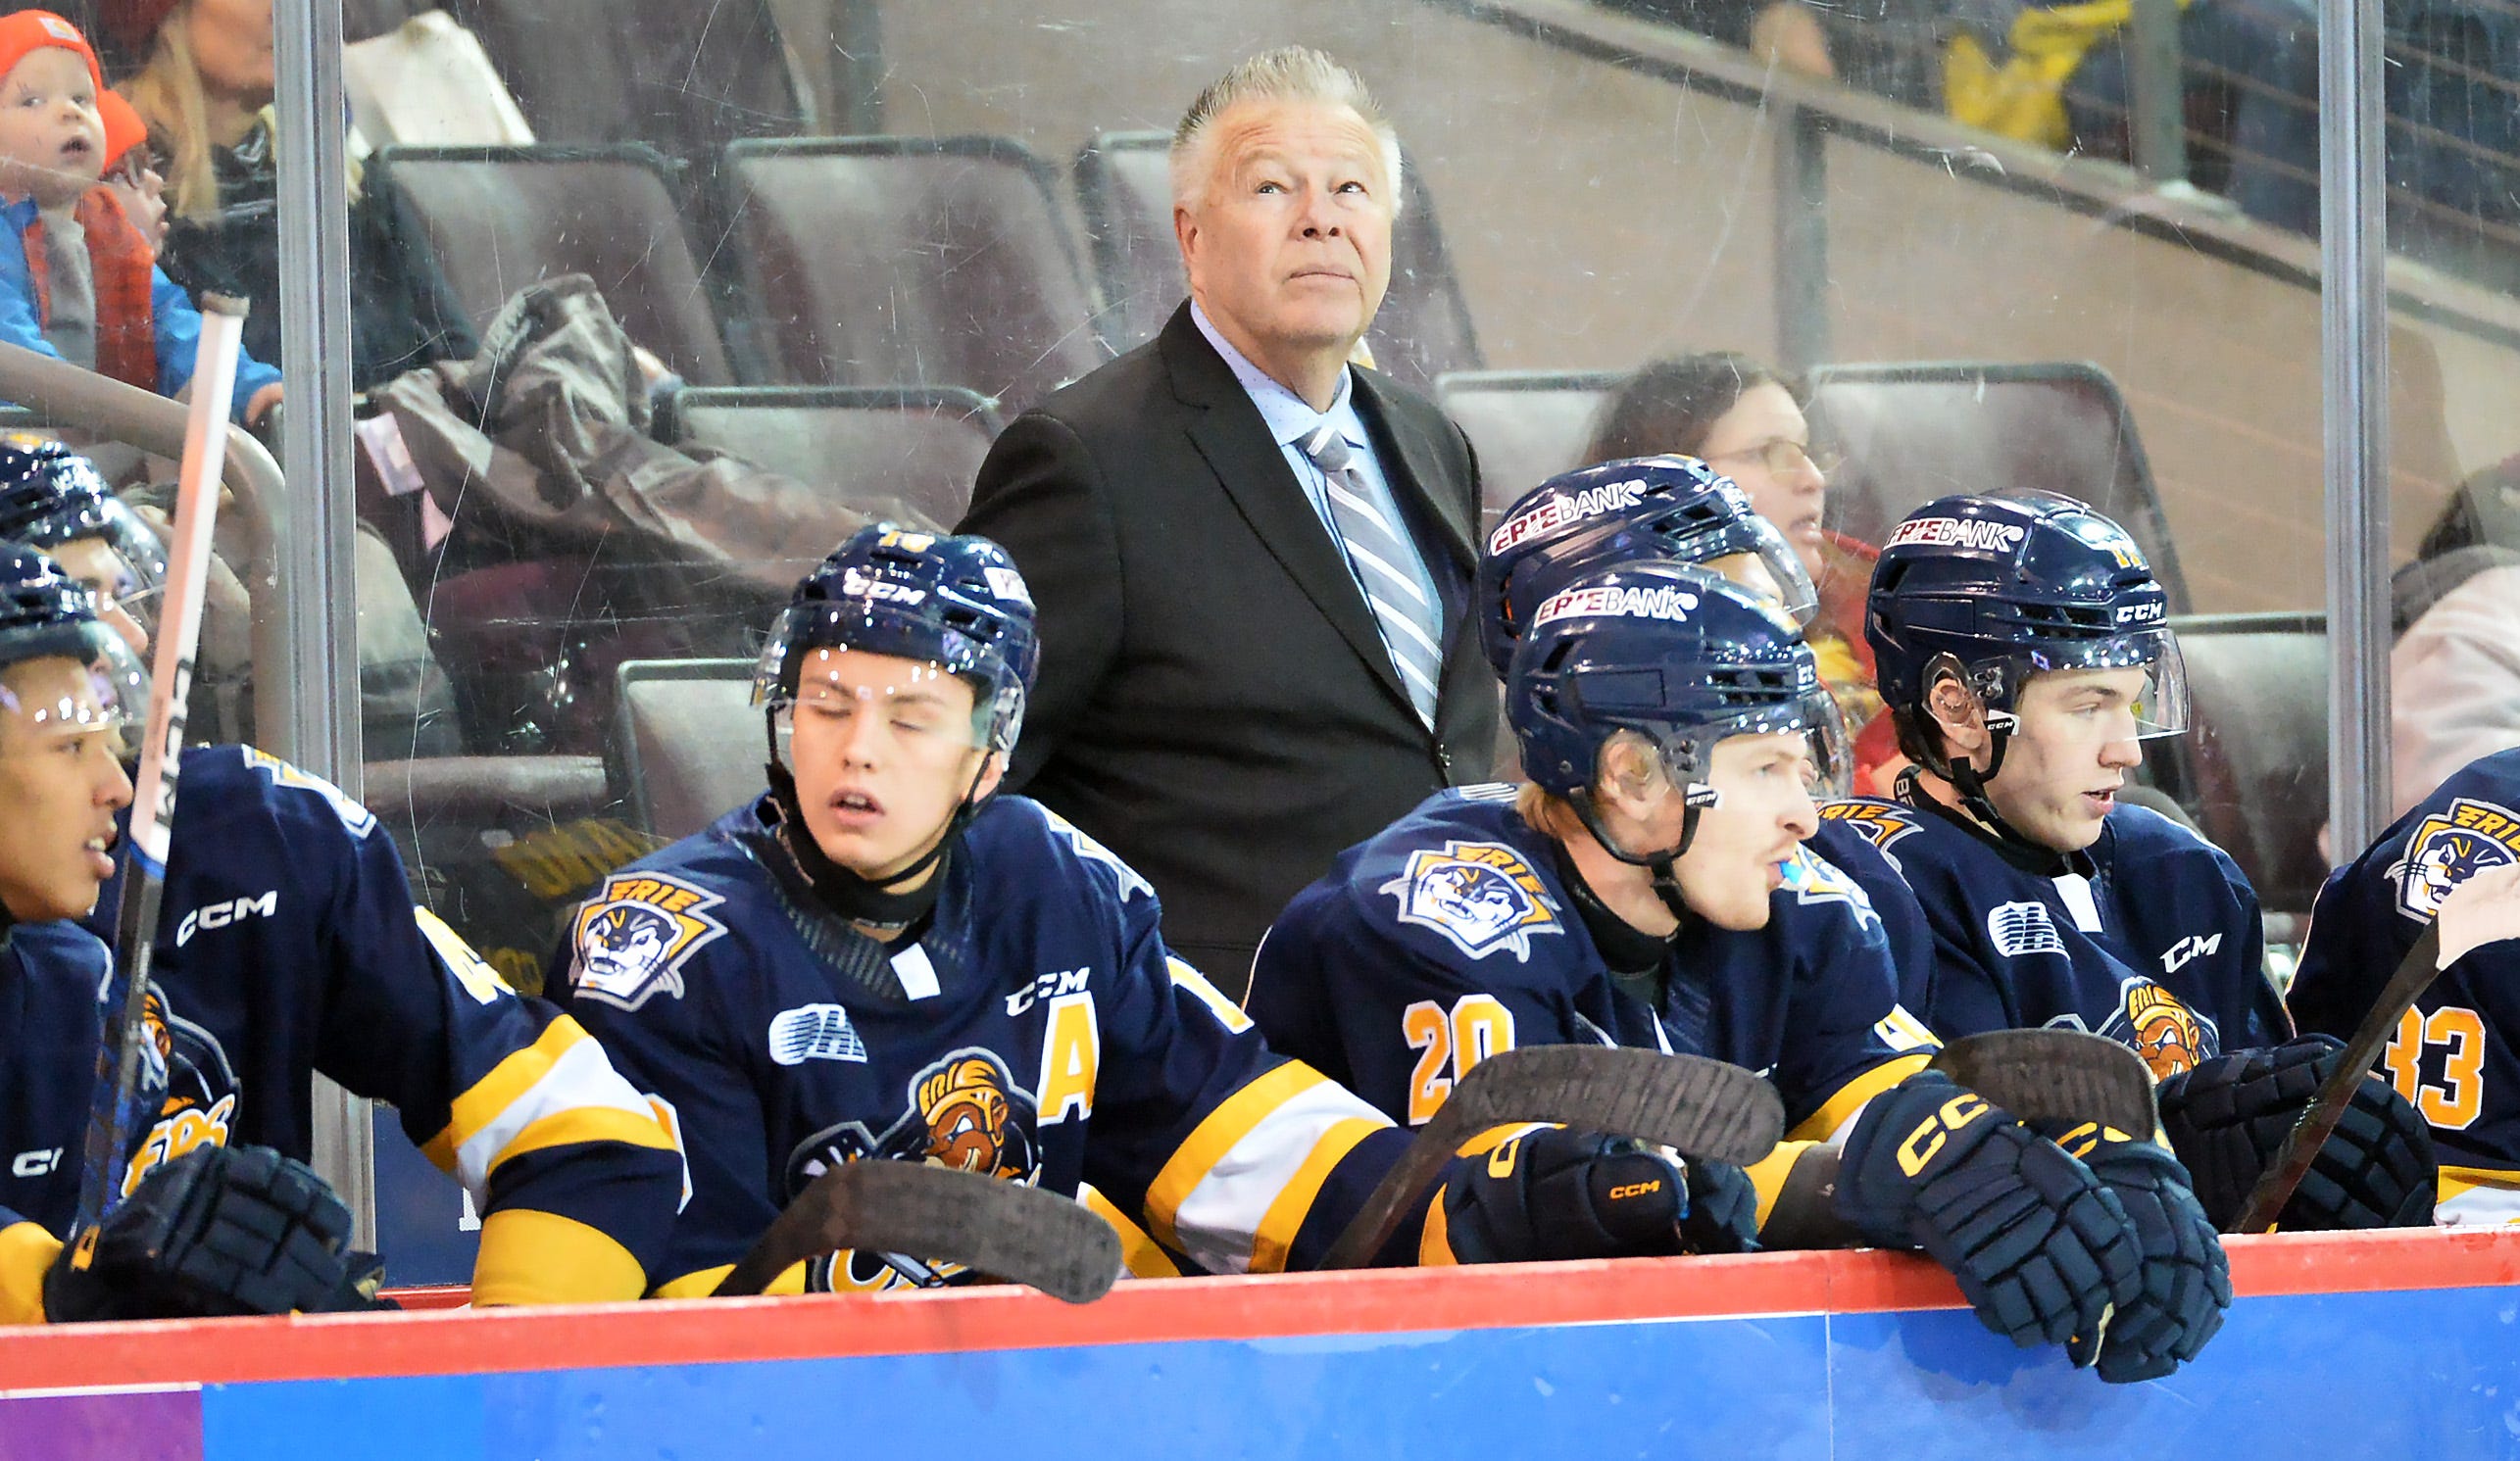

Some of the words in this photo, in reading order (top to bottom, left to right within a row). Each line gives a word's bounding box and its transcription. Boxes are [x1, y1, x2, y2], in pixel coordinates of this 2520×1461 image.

[2116, 602, 2163, 623] CCM
[1988, 721, 2013, 731] CCM
[1817, 804, 1890, 820] RIE
[1456, 846, 1546, 894] ERIE
[176, 890, 277, 948] CCM
[608, 879, 701, 912] ERIE
[1006, 966, 1090, 1017] CCM
[1036, 990, 1100, 1128] A
[1402, 993, 1516, 1126] 20
[1897, 1093, 1989, 1178] CC
[1609, 1179, 1661, 1200] CCM
